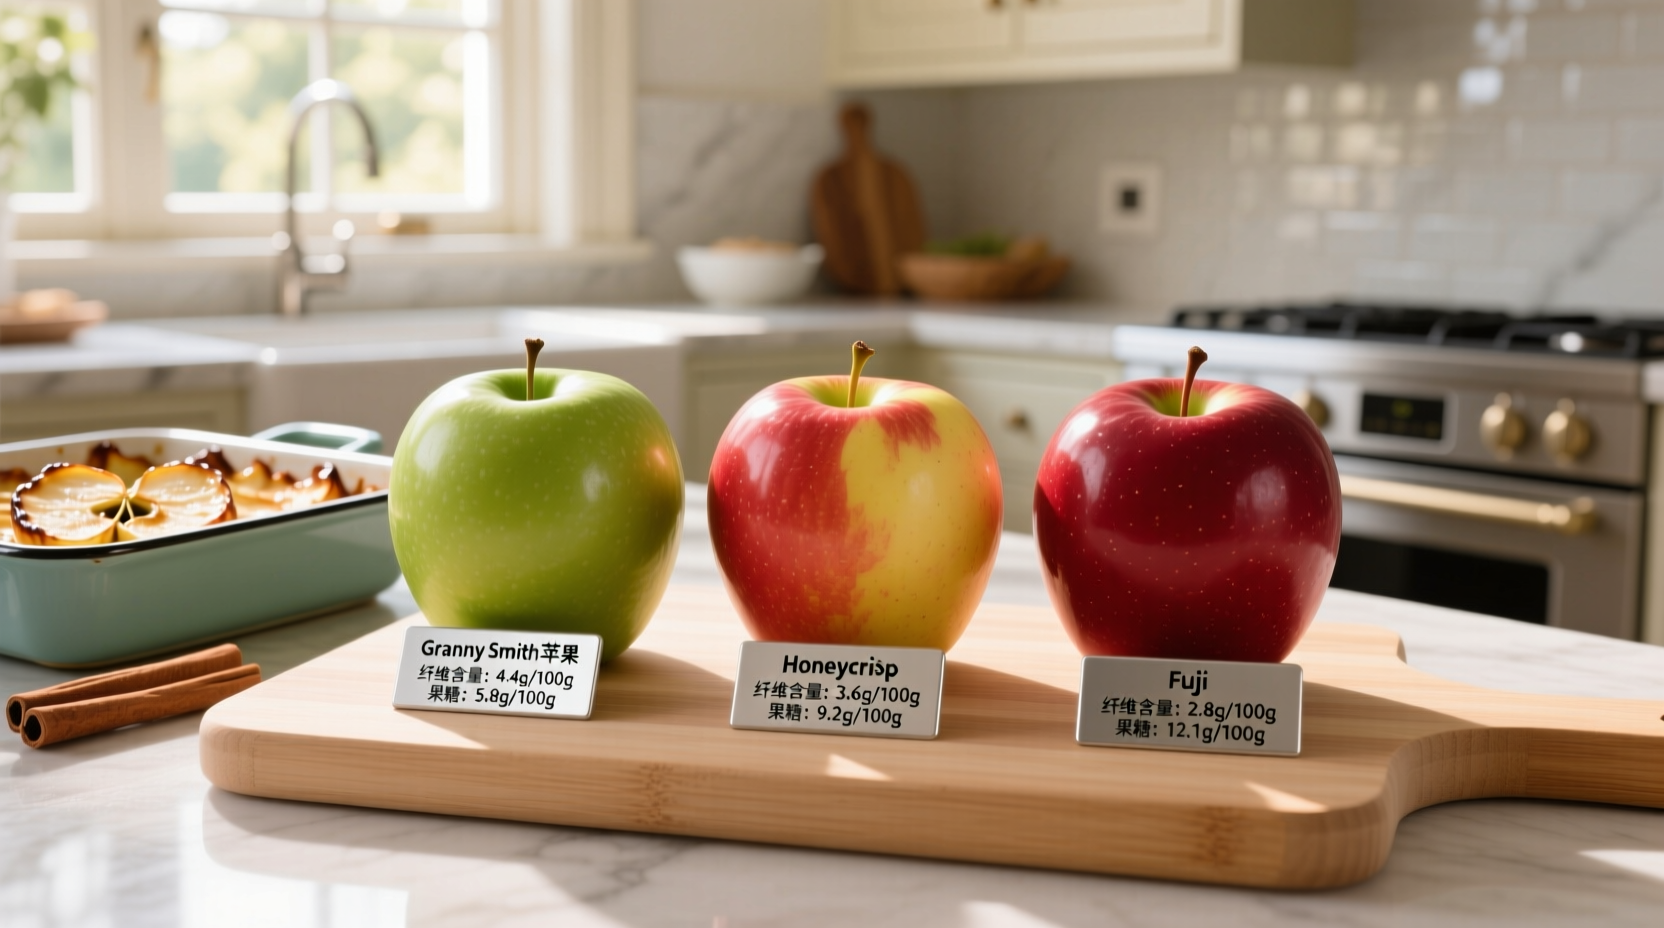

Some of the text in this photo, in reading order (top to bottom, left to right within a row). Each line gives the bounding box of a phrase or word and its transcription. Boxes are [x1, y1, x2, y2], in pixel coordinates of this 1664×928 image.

[421, 639, 485, 662] Granny
[496, 669, 574, 690] 4.4g/100g
[782, 654, 899, 682] Honeycrisp
[1169, 669, 1208, 696] Fuji
[475, 687, 556, 710] 5.8g/100g
[835, 685, 921, 708] 3.6g/100g
[817, 705, 902, 728] 9.2g/100g
[1187, 701, 1276, 724] 2.8g/100g
[1167, 722, 1265, 746] 12.1g/100g
